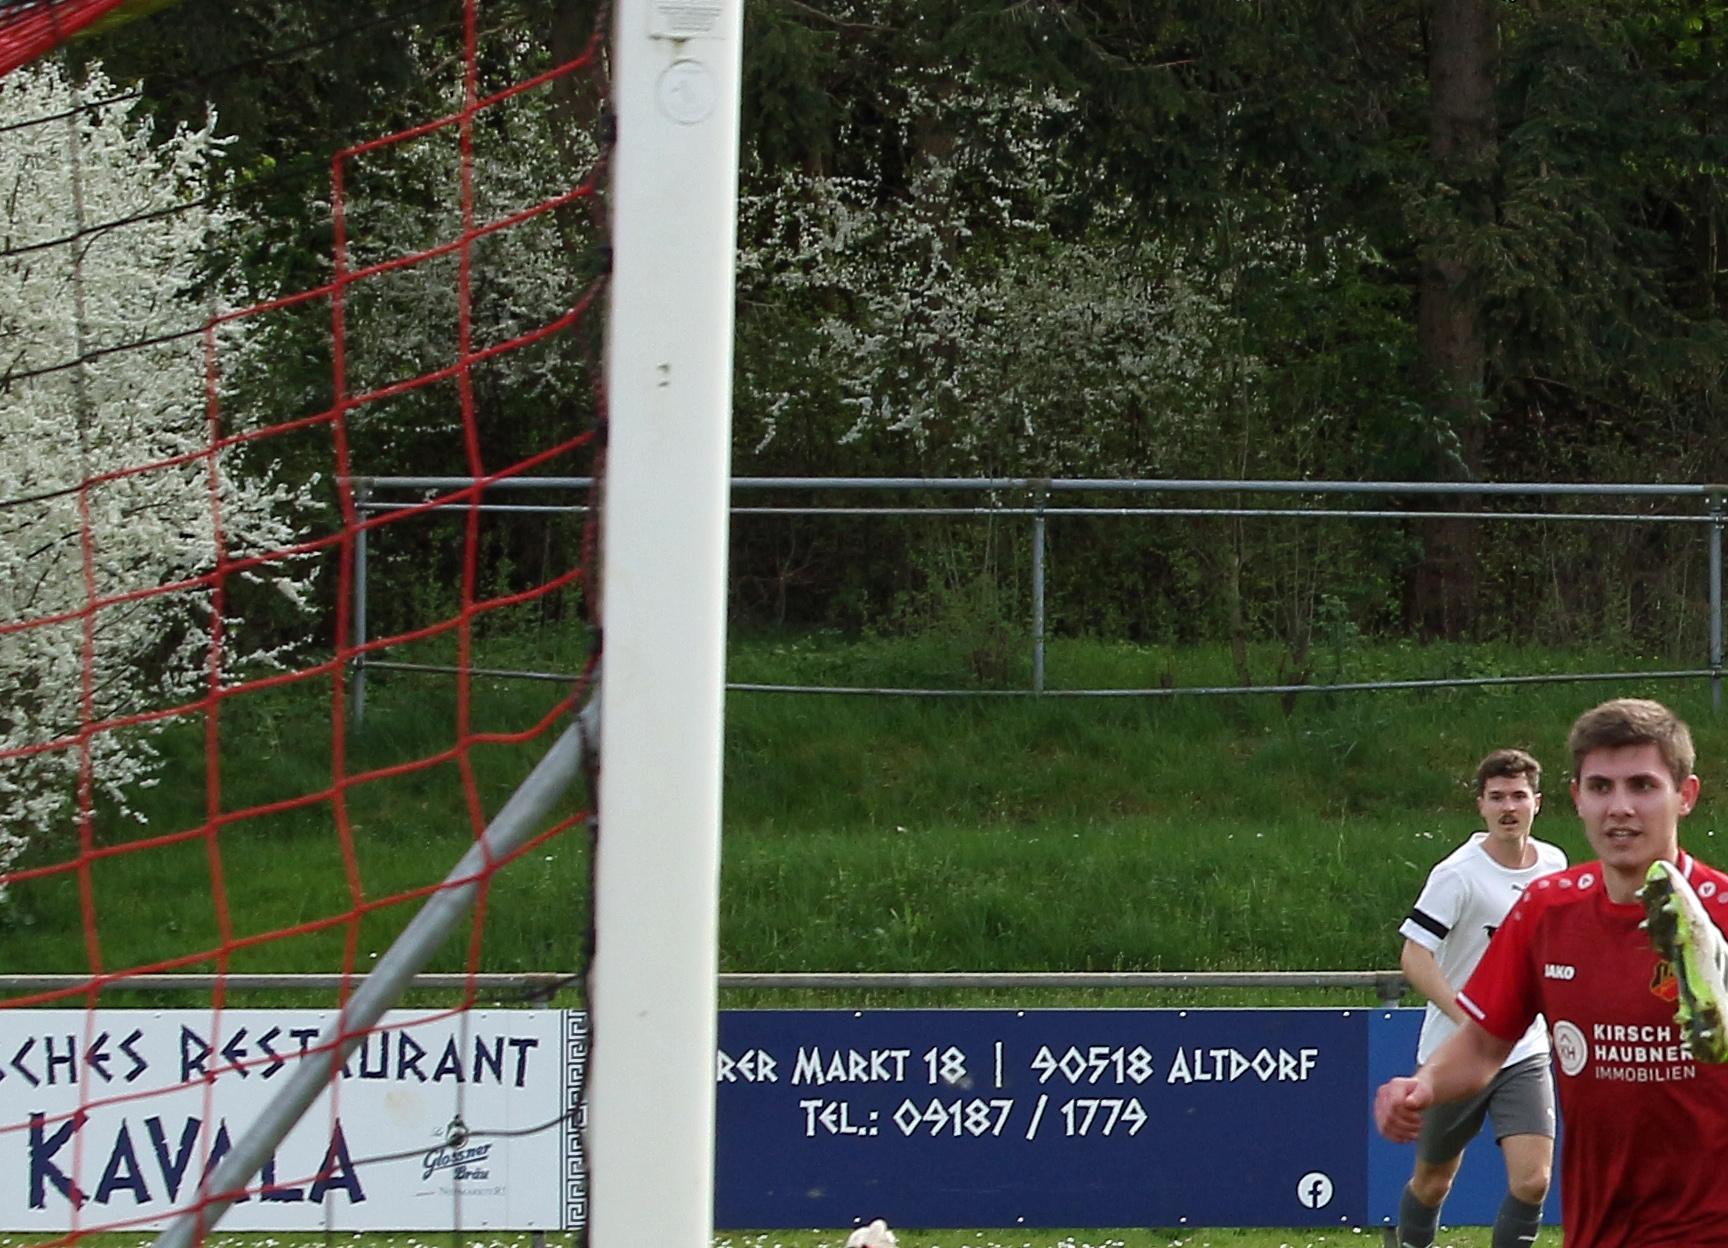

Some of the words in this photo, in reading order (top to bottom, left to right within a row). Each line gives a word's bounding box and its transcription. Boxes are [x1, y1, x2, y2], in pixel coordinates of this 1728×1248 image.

[1594, 1023, 1672, 1043] KIRSCH
[0, 1029, 148, 1087] CHES
[791, 1046, 911, 1085] MARKT
[923, 1046, 967, 1085] 18
[1030, 1045, 1154, 1085] 90518
[1167, 1046, 1319, 1083] ALTDORF
[1595, 1065, 1696, 1083] IMMOBILIEN
[1060, 1097, 1148, 1137] 1779
